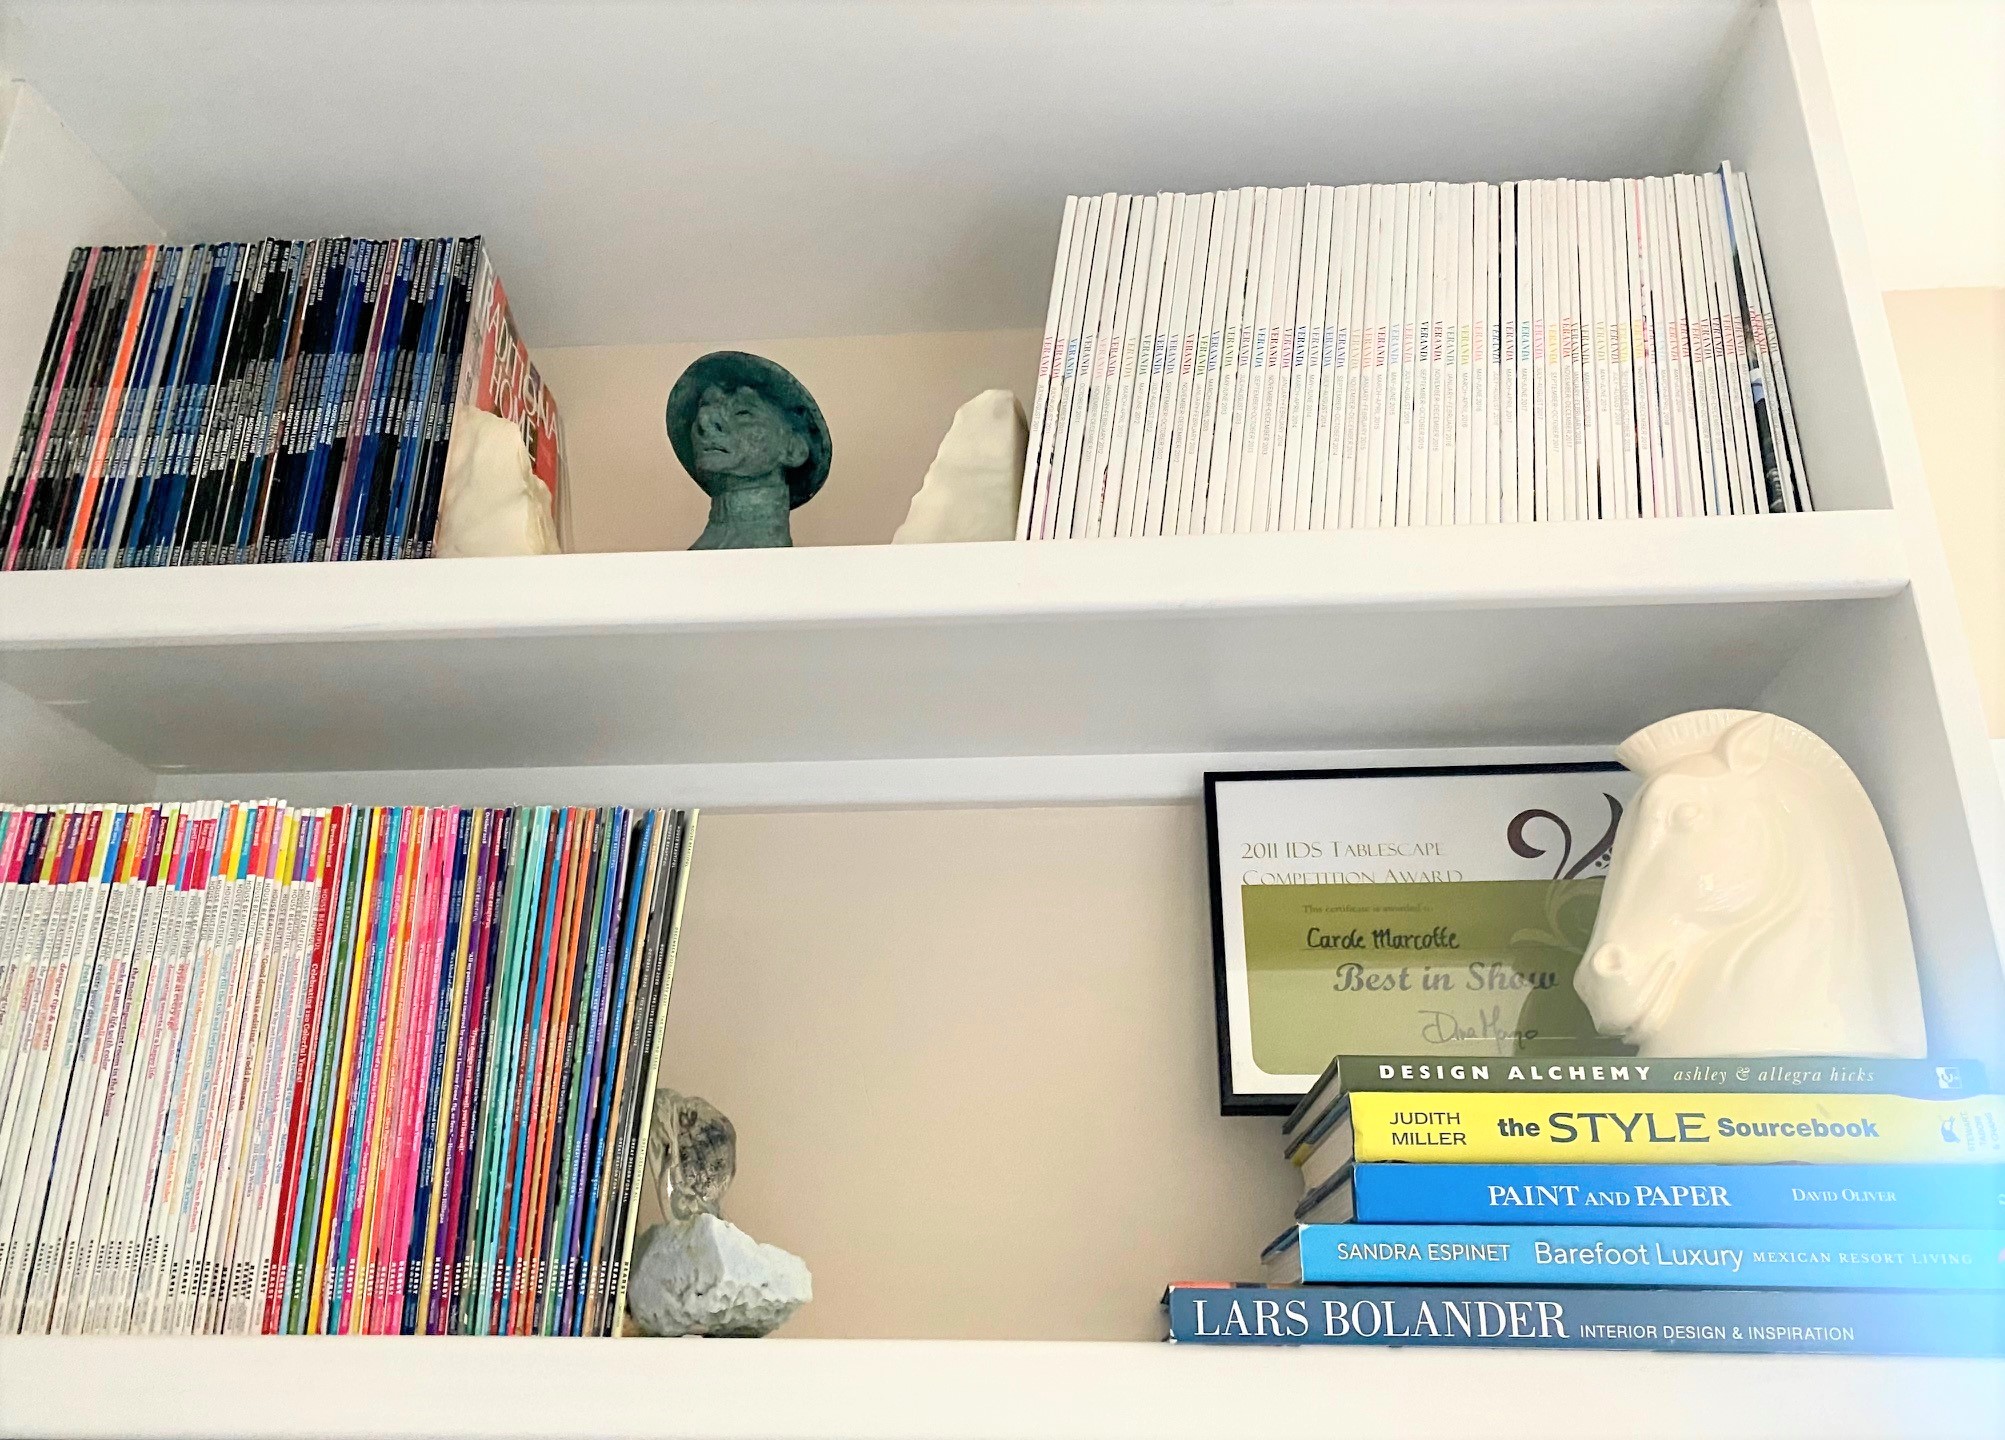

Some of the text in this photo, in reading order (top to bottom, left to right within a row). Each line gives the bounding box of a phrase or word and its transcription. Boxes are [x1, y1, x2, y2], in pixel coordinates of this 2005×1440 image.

[1208, 331, 1220, 372] VERANDA
[1225, 326, 1236, 367] VERANDA
[1240, 326, 1252, 367] VERANDA
[1255, 328, 1267, 368] VERANDA
[1269, 327, 1280, 368] VERANDA
[1295, 326, 1307, 367] VERANDA
[1324, 326, 1335, 367] VERANDA
[1337, 328, 1347, 368] VERANDA
[1363, 328, 1373, 368] VERANDA
[1376, 326, 1387, 367] VERANDA
[1390, 324, 1400, 365] VERANDA
[1403, 322, 1413, 364] VERANDA
[1419, 321, 1430, 362] VERANDA
[1434, 321, 1444, 362] VERANDA
[1505, 321, 1515, 362] VERANDA
[1521, 321, 1531, 362] VERANDA
[1534, 319, 1543, 359] VERANDA
[1548, 324, 1558, 365] VERANDA
[1562, 317, 1571, 359] VERANDA
[1571, 322, 1580, 364] VERANDA
[1668, 321, 1680, 361] VERANDA
[1691, 322, 1702, 363] VERANDA
[1701, 319, 1713, 359] VERANDA
[1712, 317, 1724, 357] VERANDA
[1723, 314, 1735, 355] VERANDA
[1764, 312, 1779, 353] VERANDA
[1040, 336, 1052, 377] VERANDA
[1064, 338, 1078, 380] VERANDA
[1080, 335, 1093, 376] VERANDA
[1139, 335, 1152, 375] VERANDA
[1153, 334, 1165, 375] VERANDA
[1166, 334, 1179, 375] VERANDA
[1183, 334, 1195, 375] VERANDA
[1197, 335, 1209, 376] VERANDA
[1241, 842, 1279, 859] 2011
[1285, 841, 1323, 859] IDS
[215, 911, 227, 949] BEAUTIFUL
[237, 905, 248, 942] BEAUTIFUL
[255, 908, 265, 946] BEAUTIFUL
[283, 913, 294, 951] BEAUTIFUL
[297, 914, 308, 952] BEAUTIFUL
[314, 913, 325, 951] BEAUTIFUL
[1333, 960, 1559, 992] Best in Show
[1378, 1064, 1875, 1085] DESIGN ALCHEMY ashley & allegra hicks
[1389, 1112, 1461, 1126] JUDITH
[1391, 1132, 1468, 1146] MILLER
[1497, 1112, 1881, 1143] the STYLE Sourcebook
[1487, 1185, 1581, 1207] PAINT
[1583, 1191, 1631, 1207] AND
[1633, 1185, 1732, 1207] PAPER
[1336, 1240, 1974, 1273] SANDRA ESPINET Barefoot Luxury MEXICAN RESORT LIVING
[1193, 1298, 1855, 1342] LARS BOLANDER INTERIOR DESIGN & INSPIRATION
